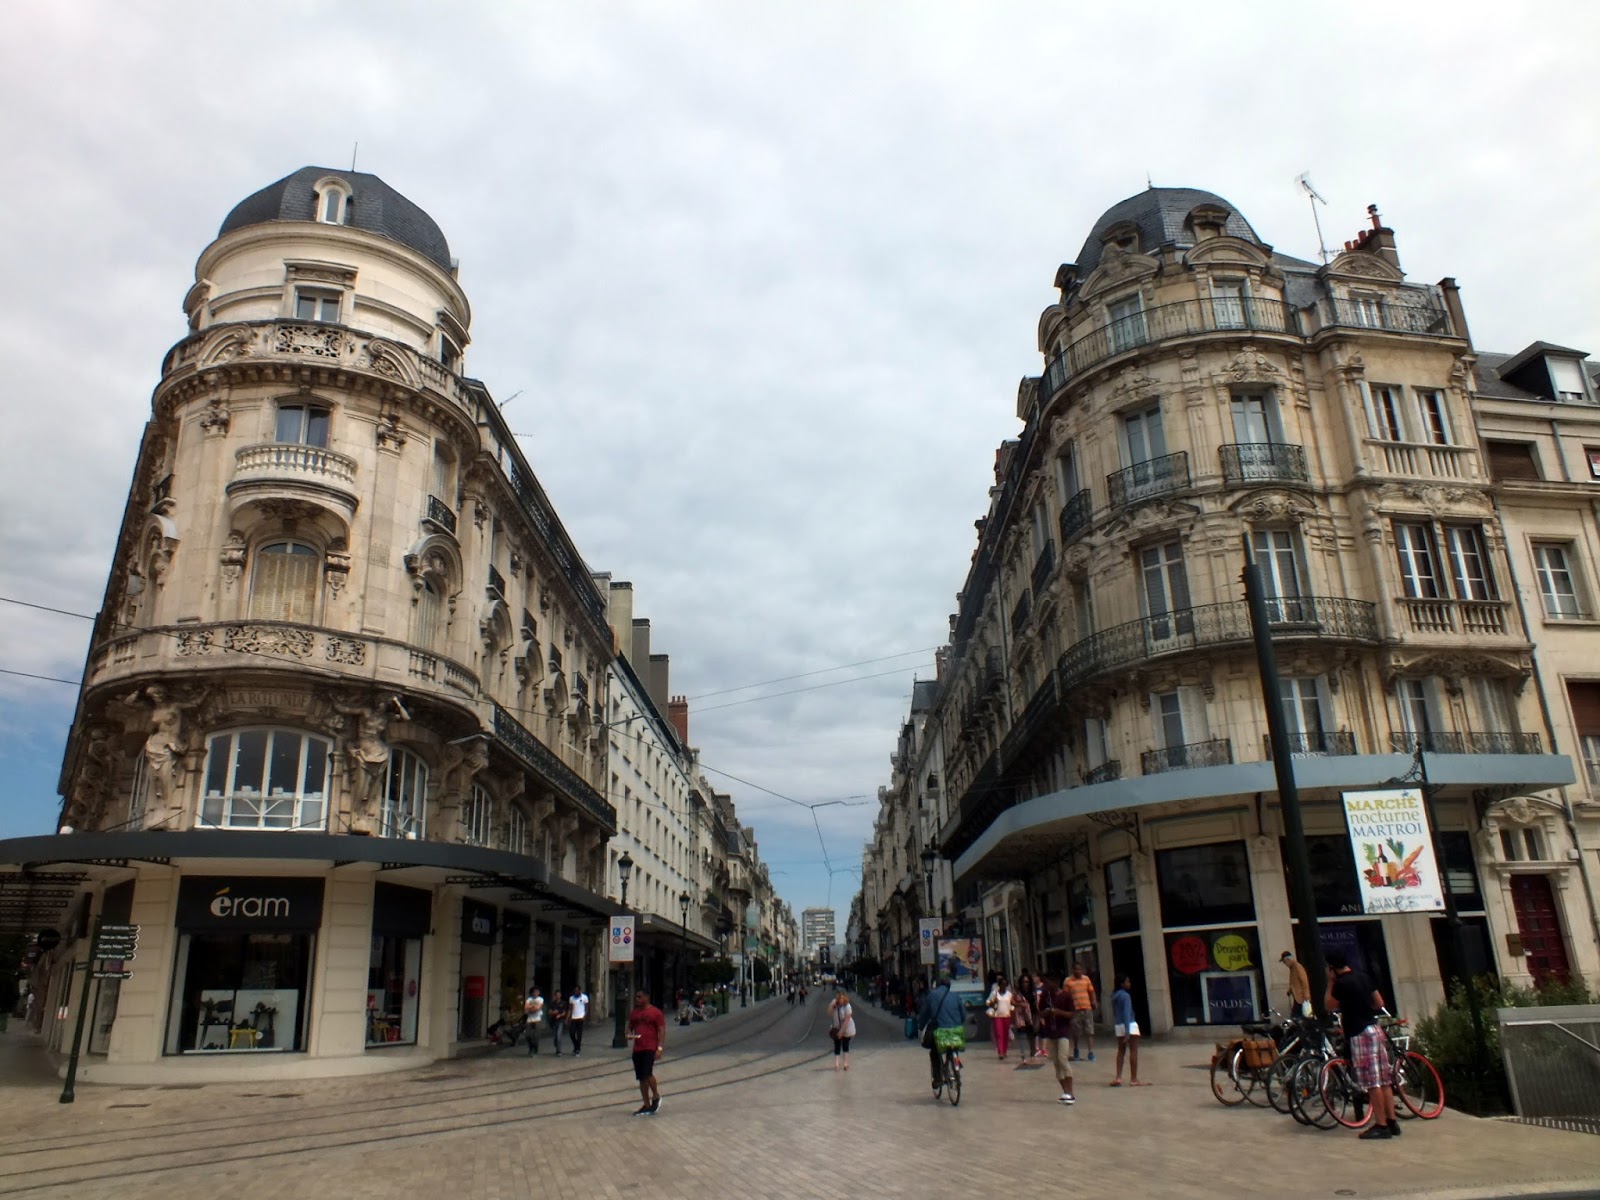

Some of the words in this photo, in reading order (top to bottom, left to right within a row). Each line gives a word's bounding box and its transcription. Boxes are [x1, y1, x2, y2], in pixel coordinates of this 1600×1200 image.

[228, 691, 247, 705] LA
[249, 691, 306, 709] ROTONDE
[1346, 796, 1419, 812] MARCHÉ
[1350, 810, 1420, 825] nocturne
[1352, 822, 1423, 838] MARTROI
[210, 886, 290, 917] éram
[1209, 999, 1253, 1009] SOLDES
